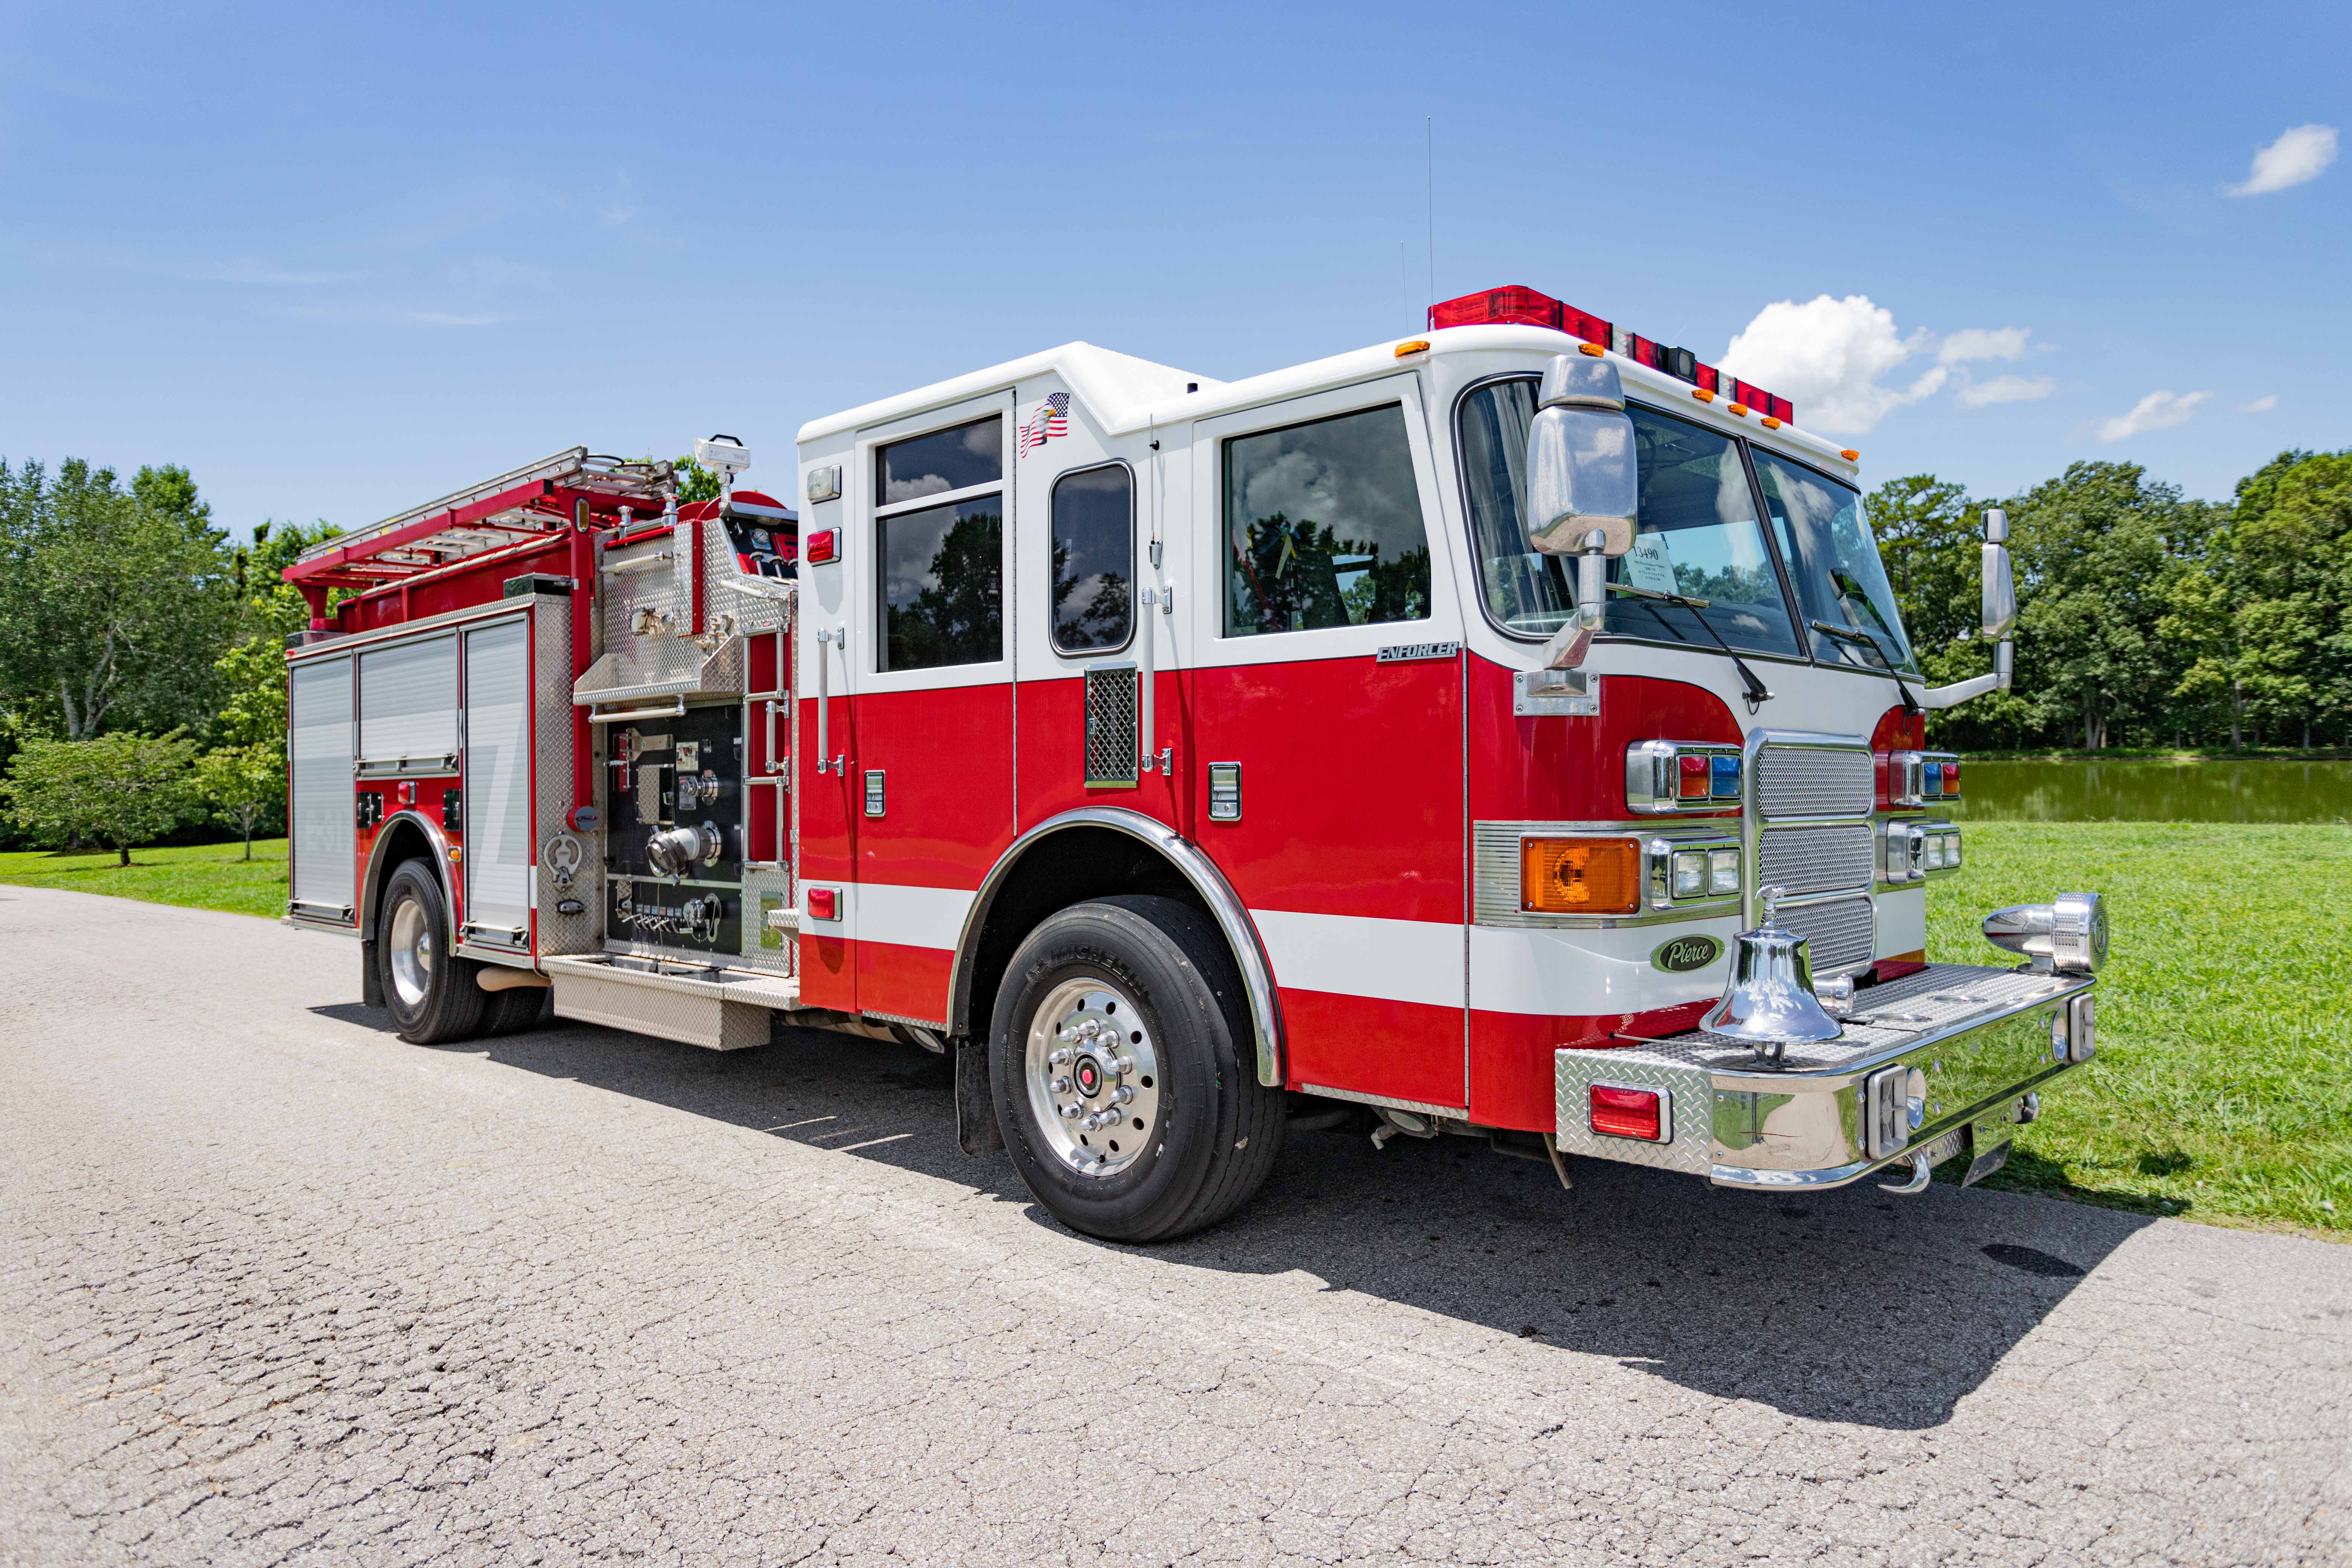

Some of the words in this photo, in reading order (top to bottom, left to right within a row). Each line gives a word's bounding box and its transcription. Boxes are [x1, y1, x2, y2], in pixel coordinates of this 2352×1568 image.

[1632, 546, 1658, 560] 13490
[1376, 642, 1459, 662] ENFORCER
[1668, 942, 1709, 968] Pierce
[1051, 943, 1149, 996] MICHELIN
